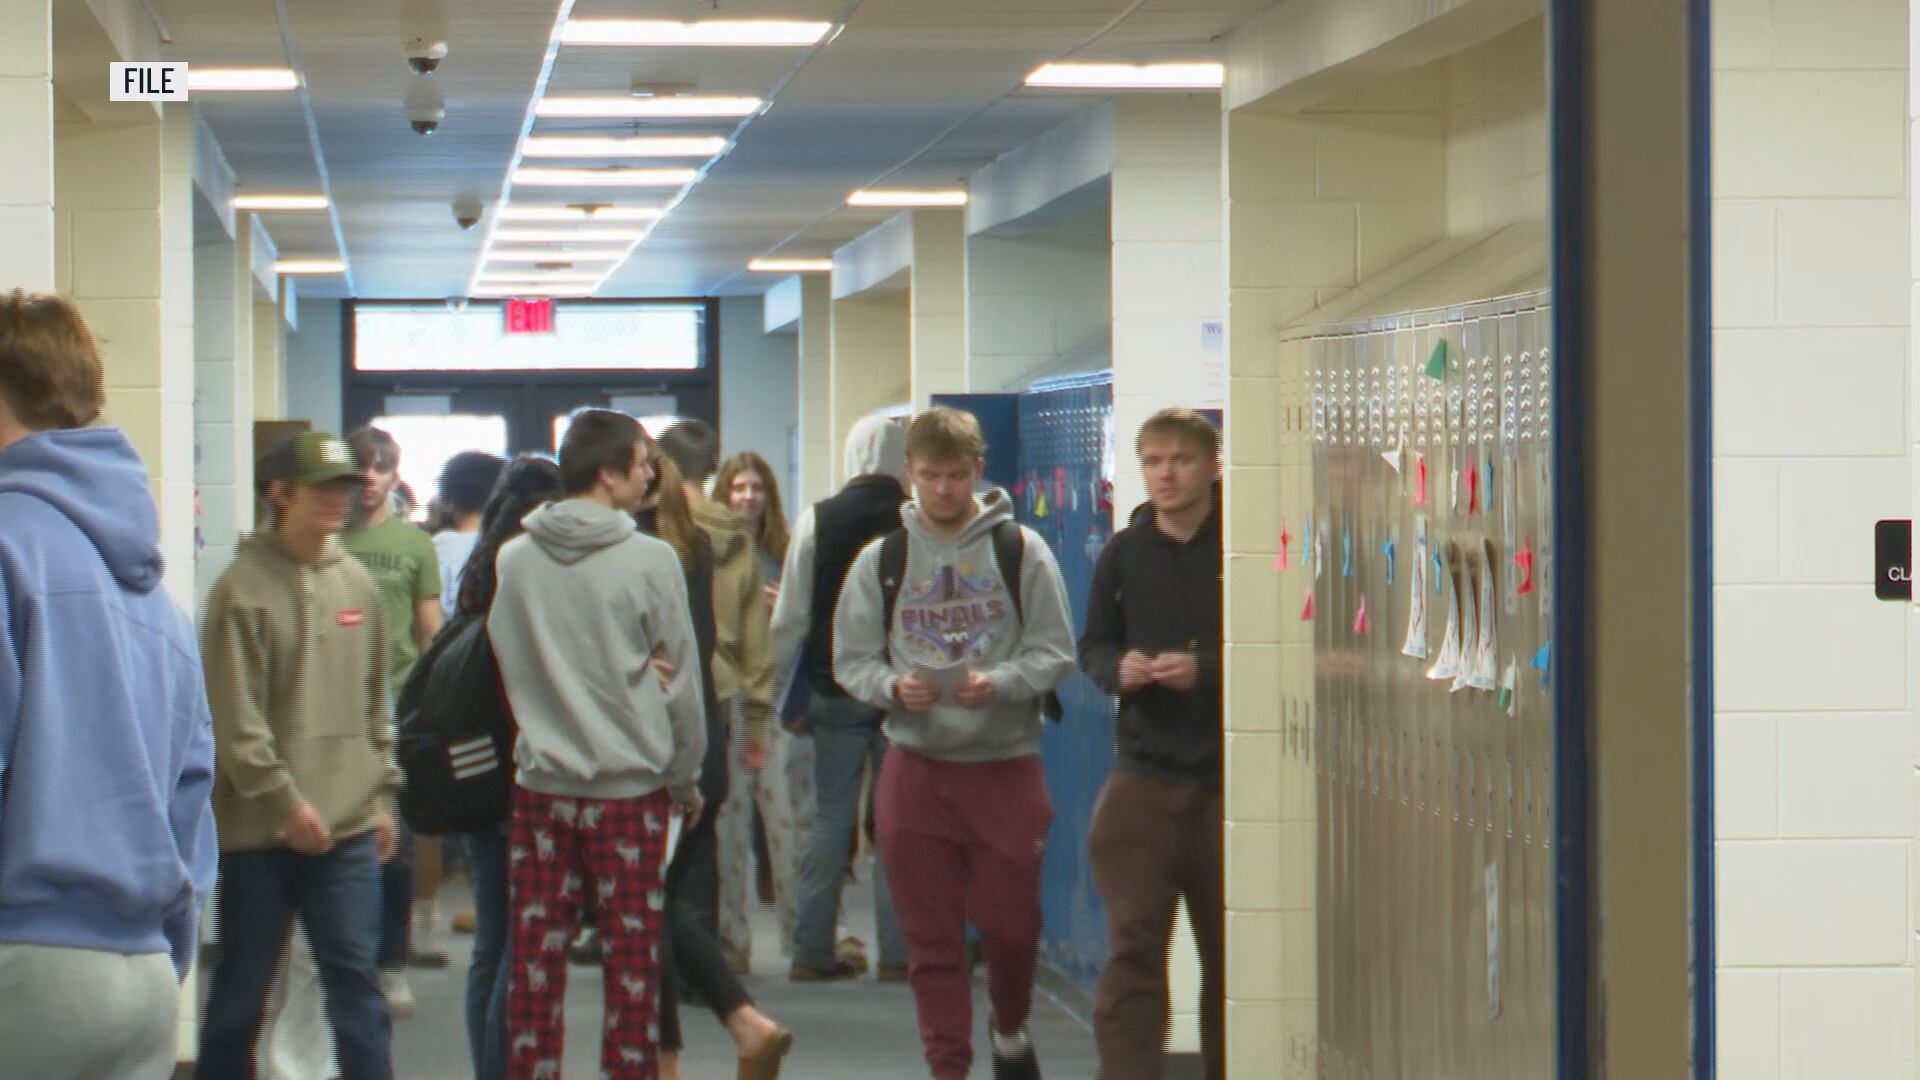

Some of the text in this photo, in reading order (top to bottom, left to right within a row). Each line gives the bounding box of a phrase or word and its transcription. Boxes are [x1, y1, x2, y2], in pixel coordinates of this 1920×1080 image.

[509, 301, 550, 333] EXIT
[1887, 566, 1912, 582] CL
[901, 600, 1008, 631] FINALS
